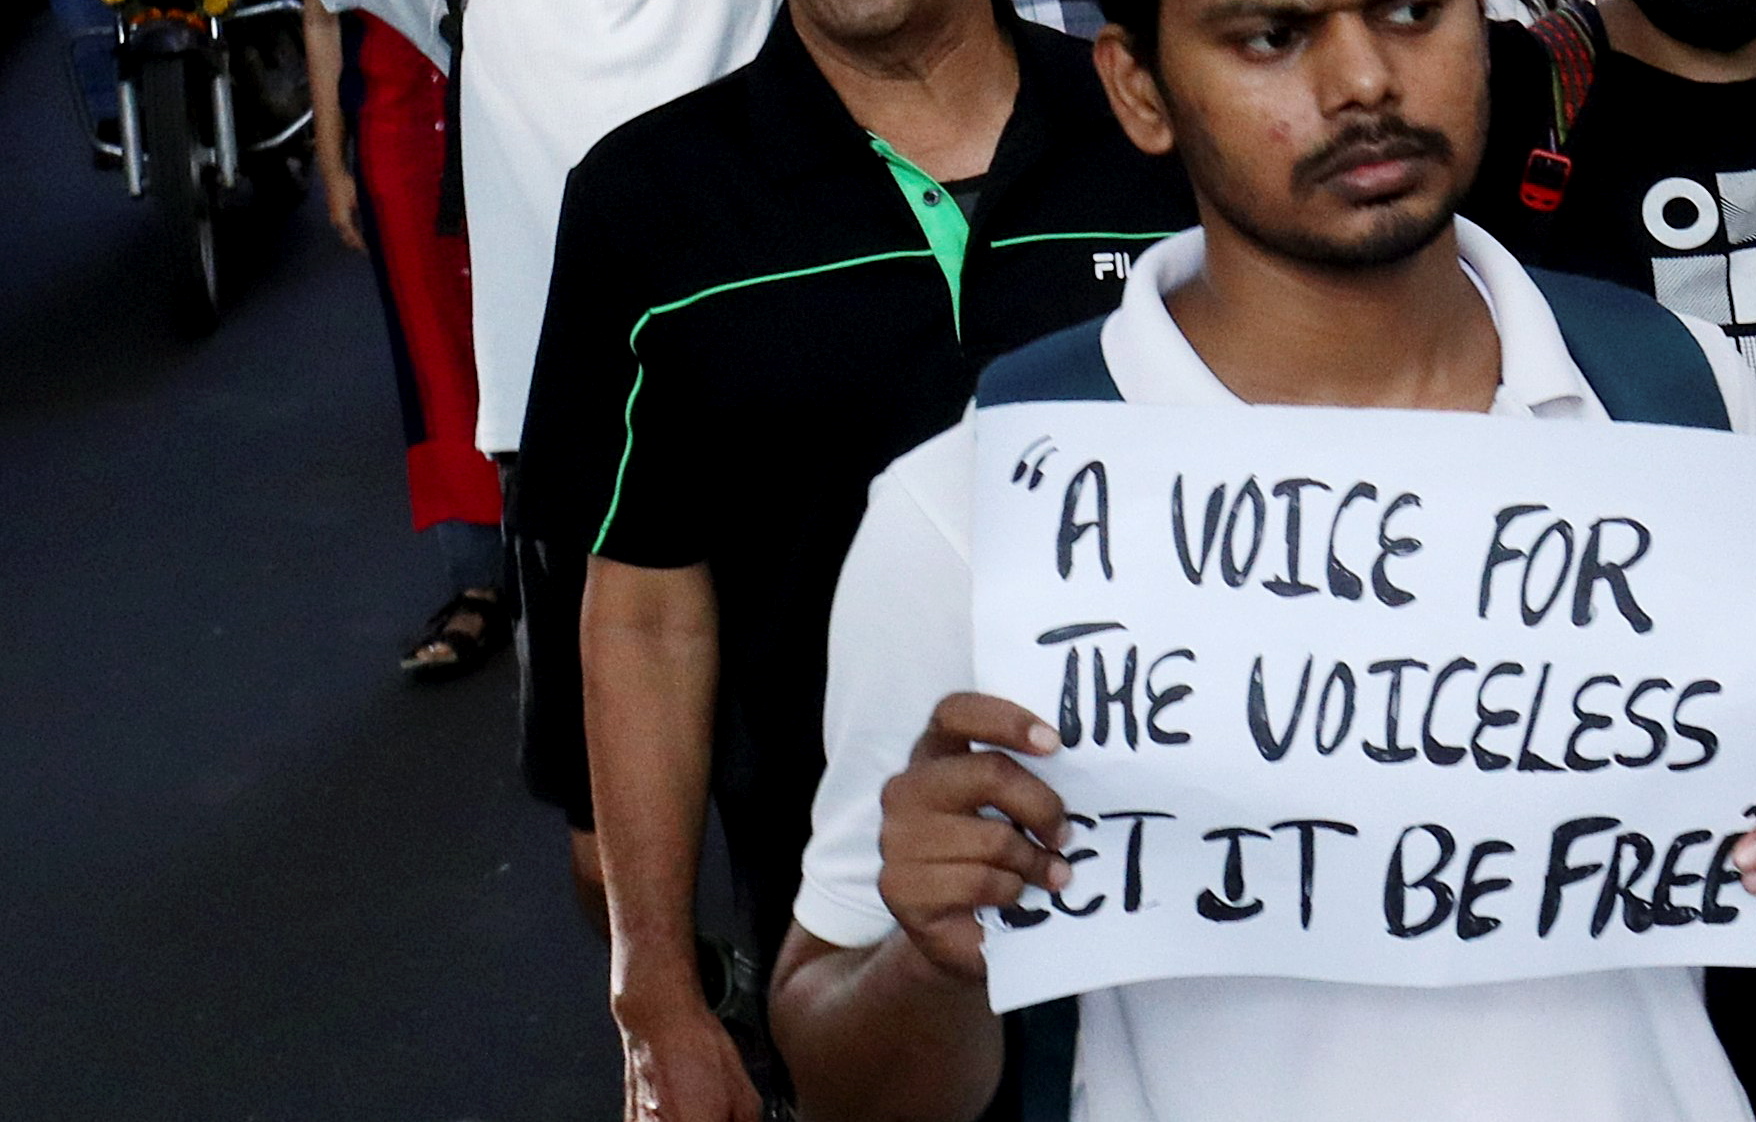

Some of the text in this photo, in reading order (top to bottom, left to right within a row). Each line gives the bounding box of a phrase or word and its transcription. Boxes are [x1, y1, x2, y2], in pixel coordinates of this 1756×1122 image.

[1171, 472, 1424, 608] VOICE
[1478, 503, 1655, 636] FOR
[1035, 621, 1723, 773] THE VOICELESS
[1194, 819, 1359, 931] IT
[1383, 821, 1516, 942] BE
